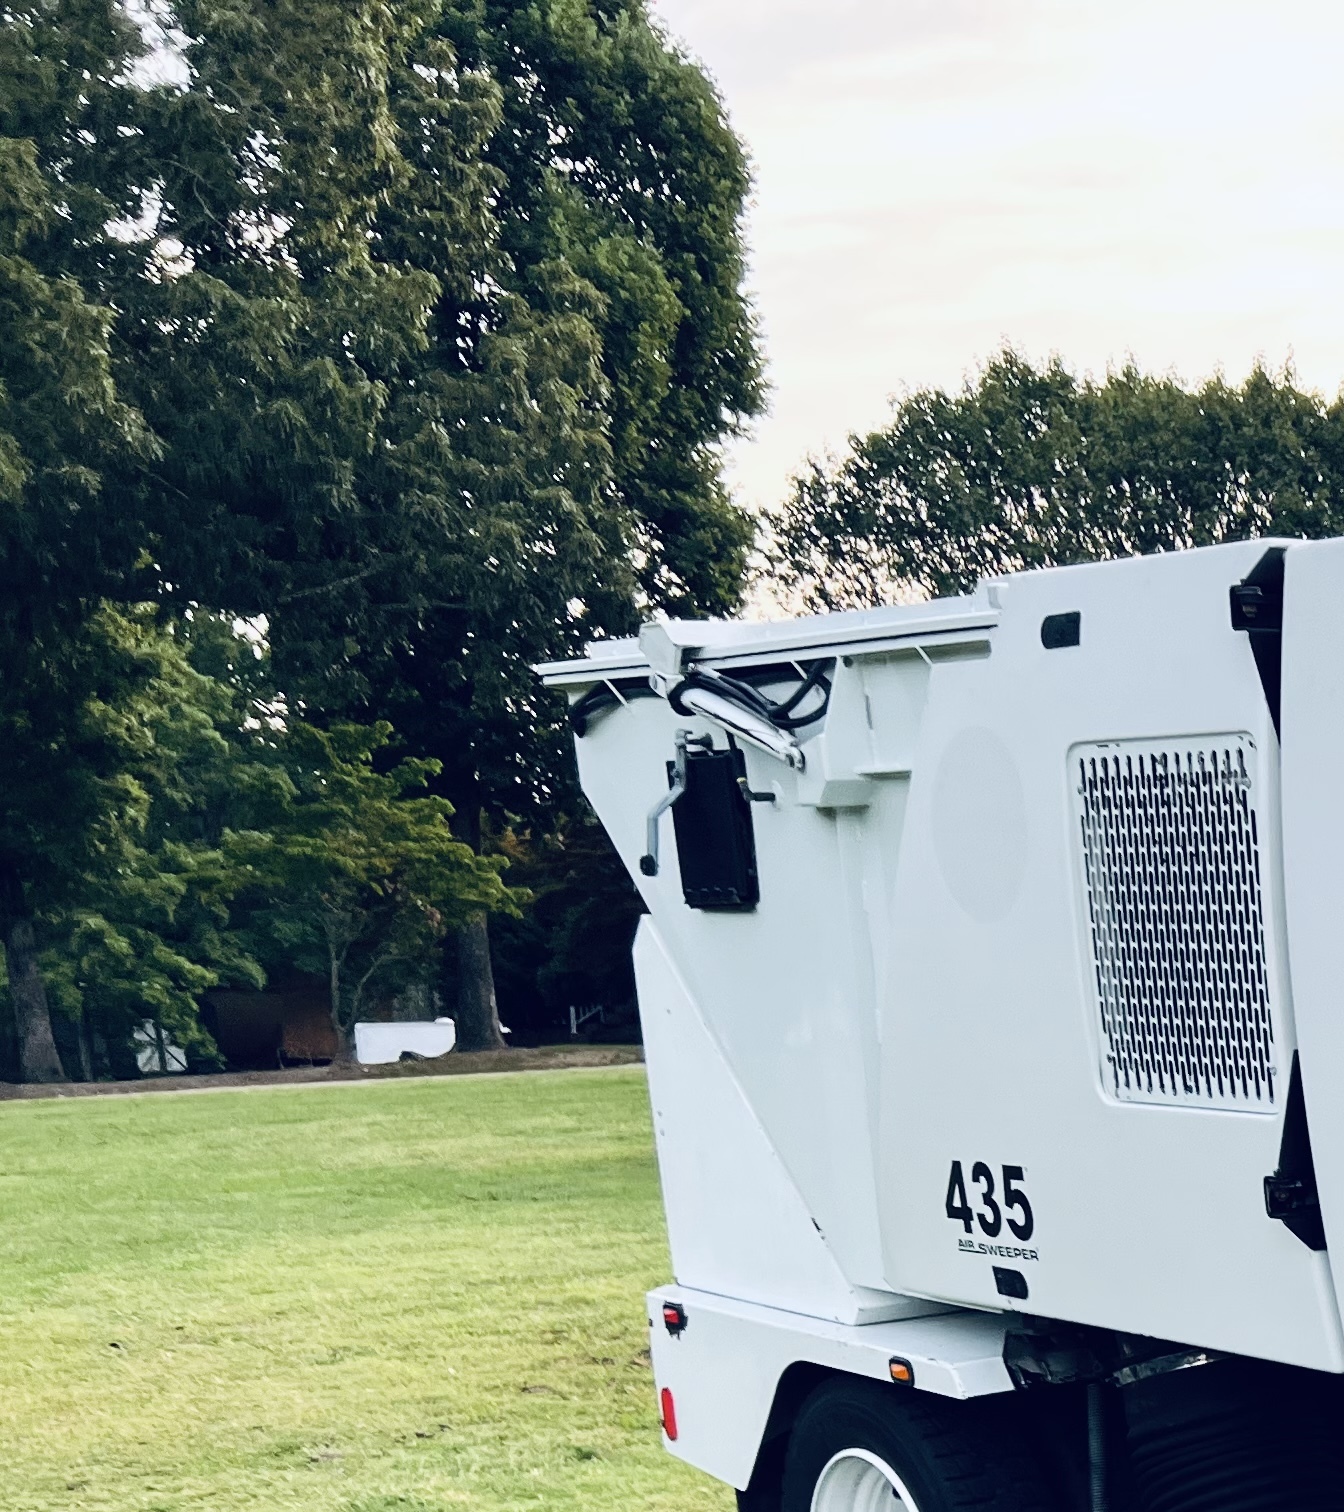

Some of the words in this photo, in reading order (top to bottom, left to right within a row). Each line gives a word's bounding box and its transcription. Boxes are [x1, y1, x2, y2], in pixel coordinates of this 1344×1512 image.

[945, 1160, 1034, 1242] 435
[957, 1238, 975, 1249] AIR
[977, 1242, 1040, 1262] SWEEPER
